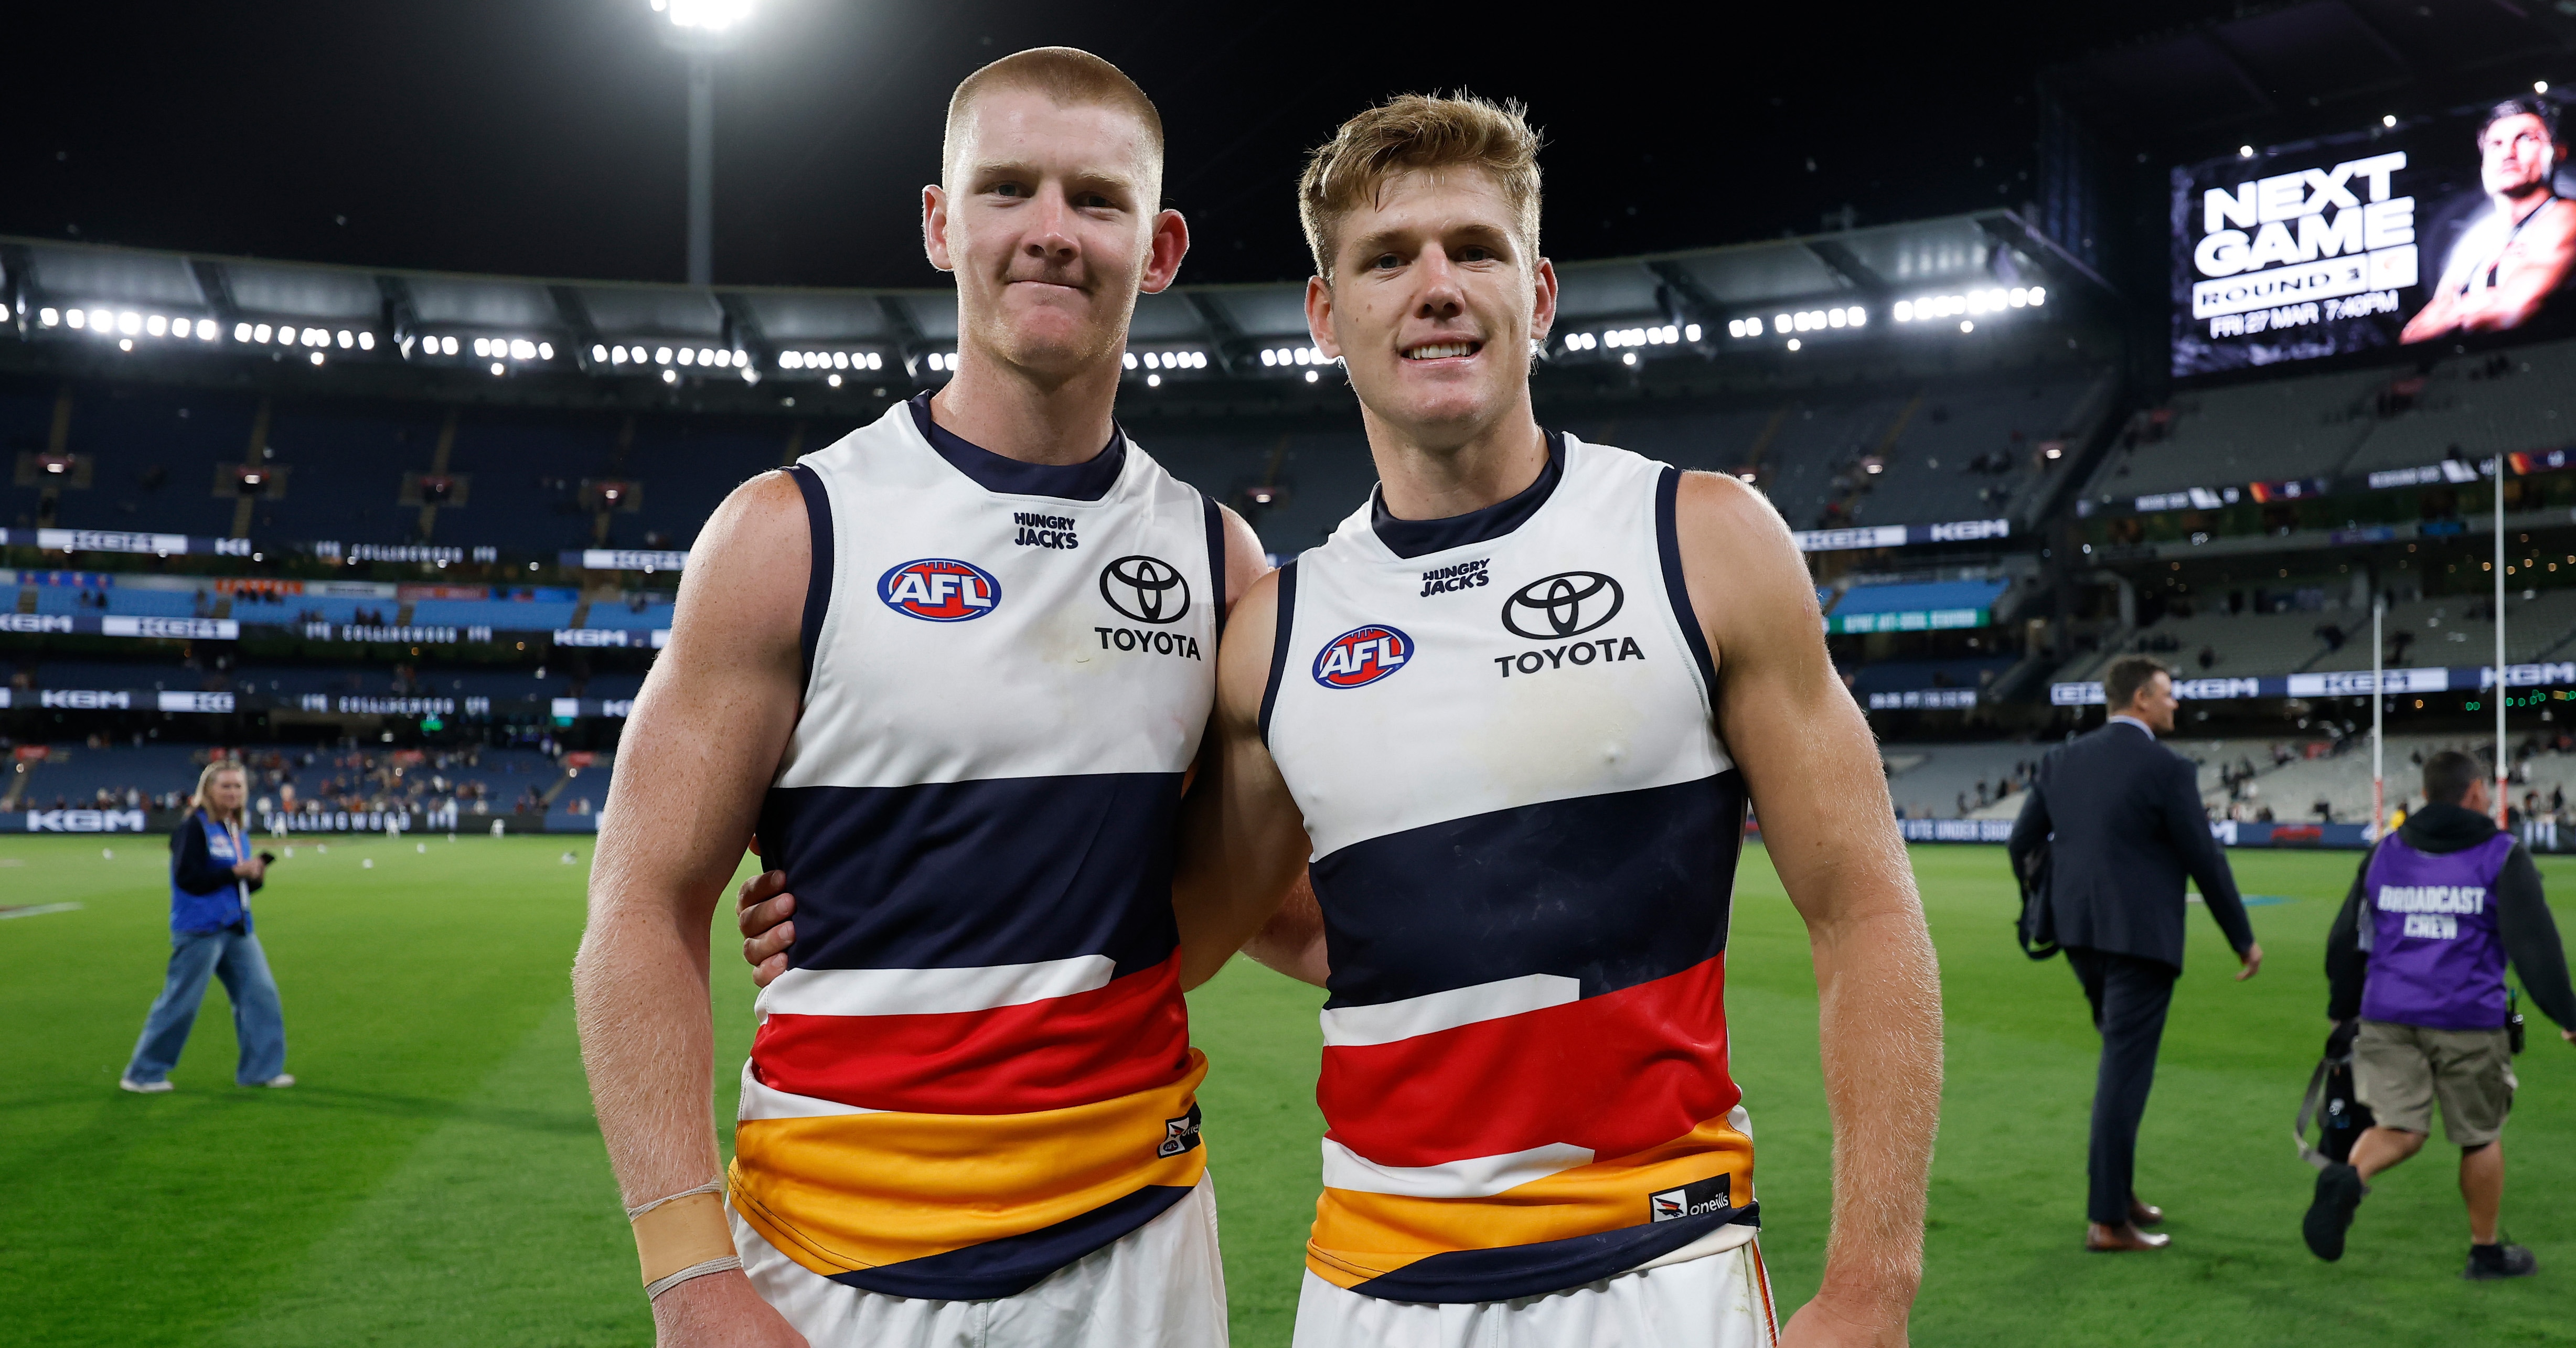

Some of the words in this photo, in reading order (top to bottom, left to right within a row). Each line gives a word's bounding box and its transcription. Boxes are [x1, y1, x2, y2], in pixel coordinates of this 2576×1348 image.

[2204, 151, 2407, 235] NEXT
[2194, 196, 2415, 277] GAME
[2203, 272, 2330, 306] ROUND
[2210, 315, 2245, 339] FRI
[2244, 310, 2271, 334] 27
[2270, 302, 2320, 330] MAR
[1013, 512, 1075, 532] HUNGRY
[1931, 518, 2009, 542] KGM
[1014, 528, 1079, 550] JACK'S
[1422, 558, 1491, 581] HUNGRY
[888, 573, 992, 607] AFL
[1420, 570, 1489, 597] JACK'S
[553, 628, 628, 647] KGM
[1095, 627, 1201, 661] TOYOTA
[1318, 636, 1404, 679] AFL
[1494, 637, 1645, 678] TOYOTA
[2172, 677, 2259, 700] KGM
[2480, 661, 2576, 689] KGM
[41, 689, 131, 709] KGM
[26, 809, 145, 832] KGM
[2377, 884, 2486, 915] BROADCAST
[2403, 914, 2457, 940] CREW
